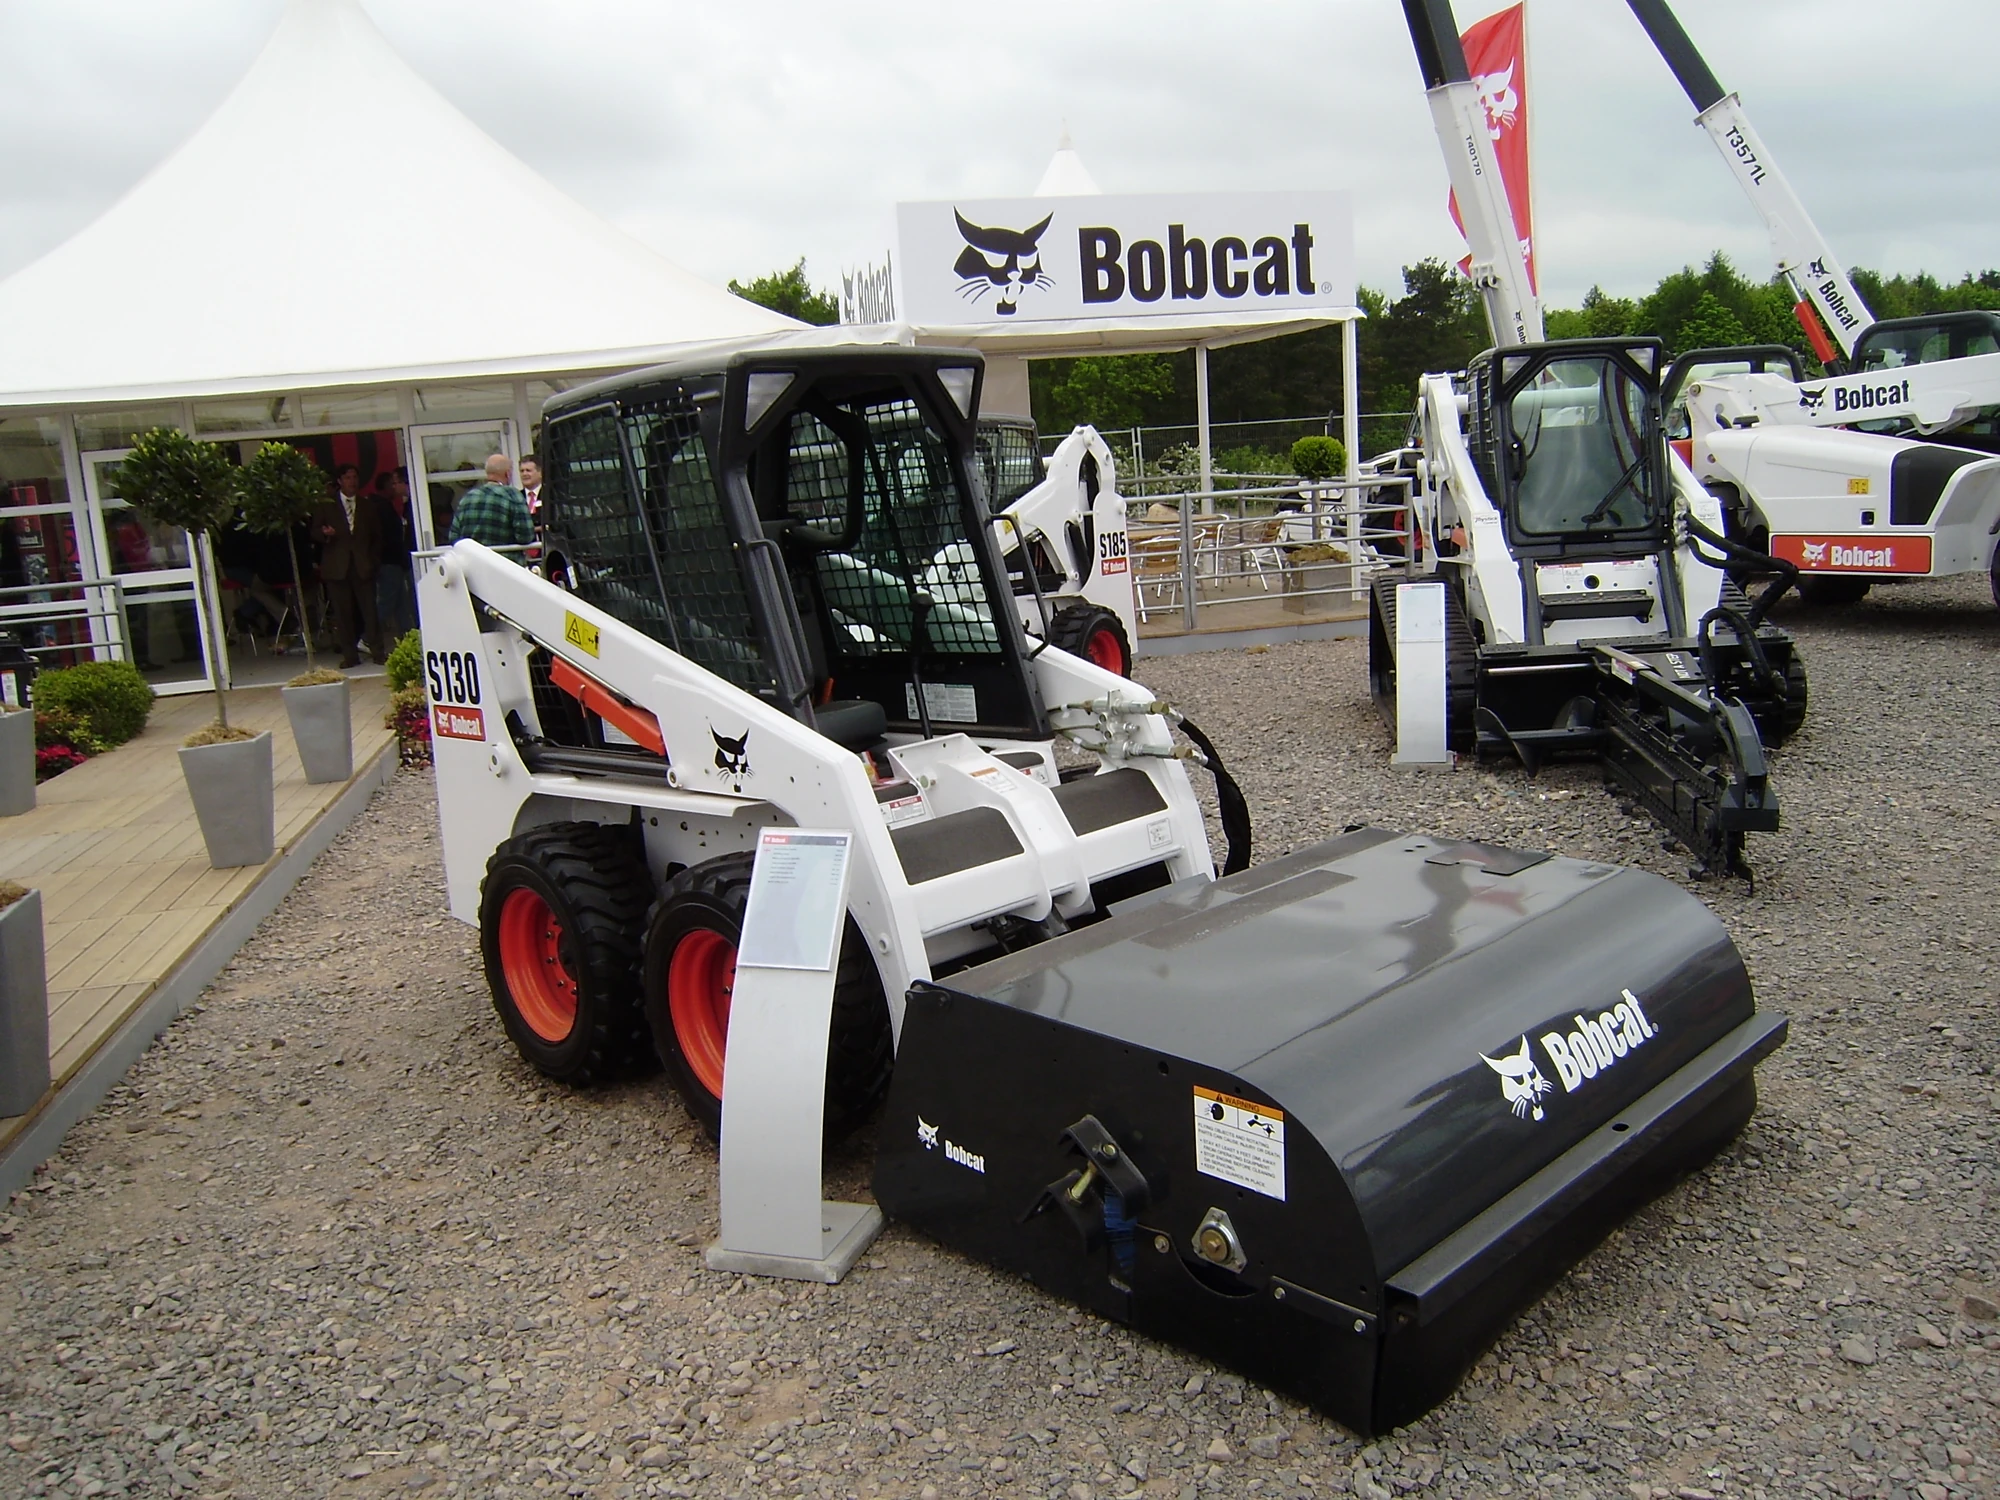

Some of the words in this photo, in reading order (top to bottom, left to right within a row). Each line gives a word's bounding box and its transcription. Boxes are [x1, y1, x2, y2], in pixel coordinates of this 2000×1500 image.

[1465, 135, 1482, 176] T40170
[1725, 125, 1766, 186] T3571L
[1078, 223, 1316, 304] Bobcat
[857, 249, 896, 324] Bobcat
[1818, 280, 1860, 331] Bobcat
[1834, 379, 1909, 412] Bobcat
[1100, 531, 1126, 558] S185
[1830, 545, 1893, 568] Bobcat
[427, 651, 481, 705] S130
[450, 714, 482, 736] Bobcat
[1540, 988, 1652, 1093] Bobcat
[1225, 1097, 1259, 1113] WARNING
[945, 1140, 985, 1173] Bobcat
